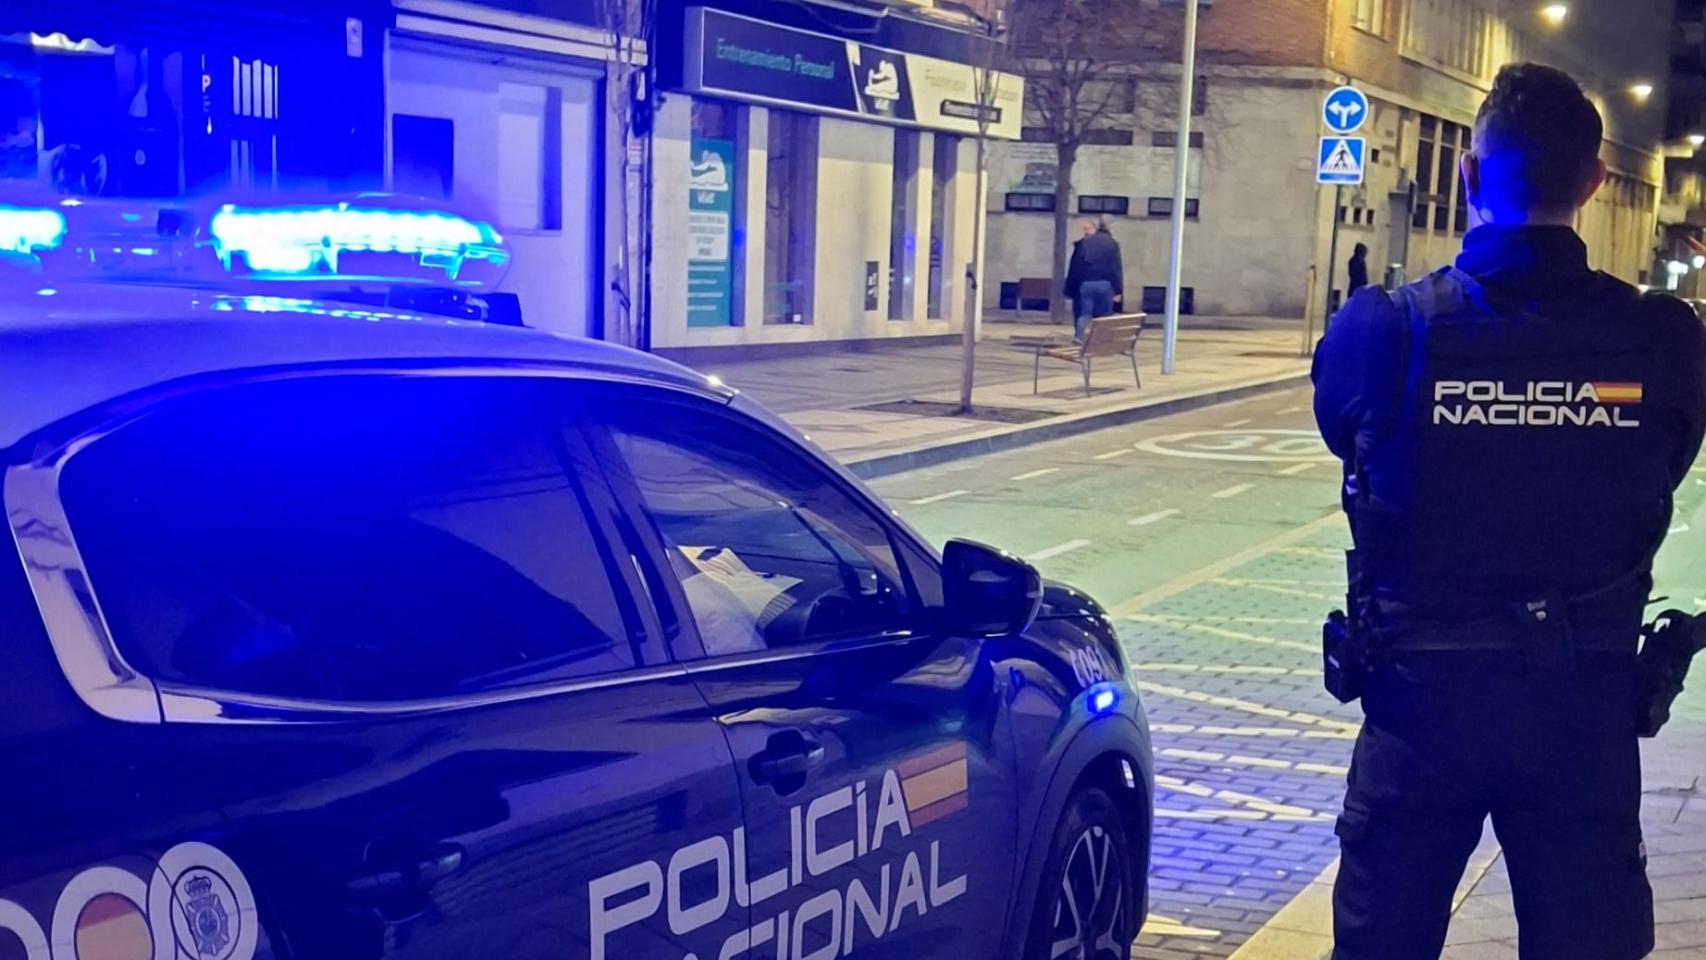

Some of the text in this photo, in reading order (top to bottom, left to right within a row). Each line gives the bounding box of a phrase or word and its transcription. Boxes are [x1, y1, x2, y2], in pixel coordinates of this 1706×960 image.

[716, 37, 835, 79] Entrenamiento Personal
[1434, 380, 1600, 403] POLICIA
[1433, 404, 1640, 427] NACIONAL
